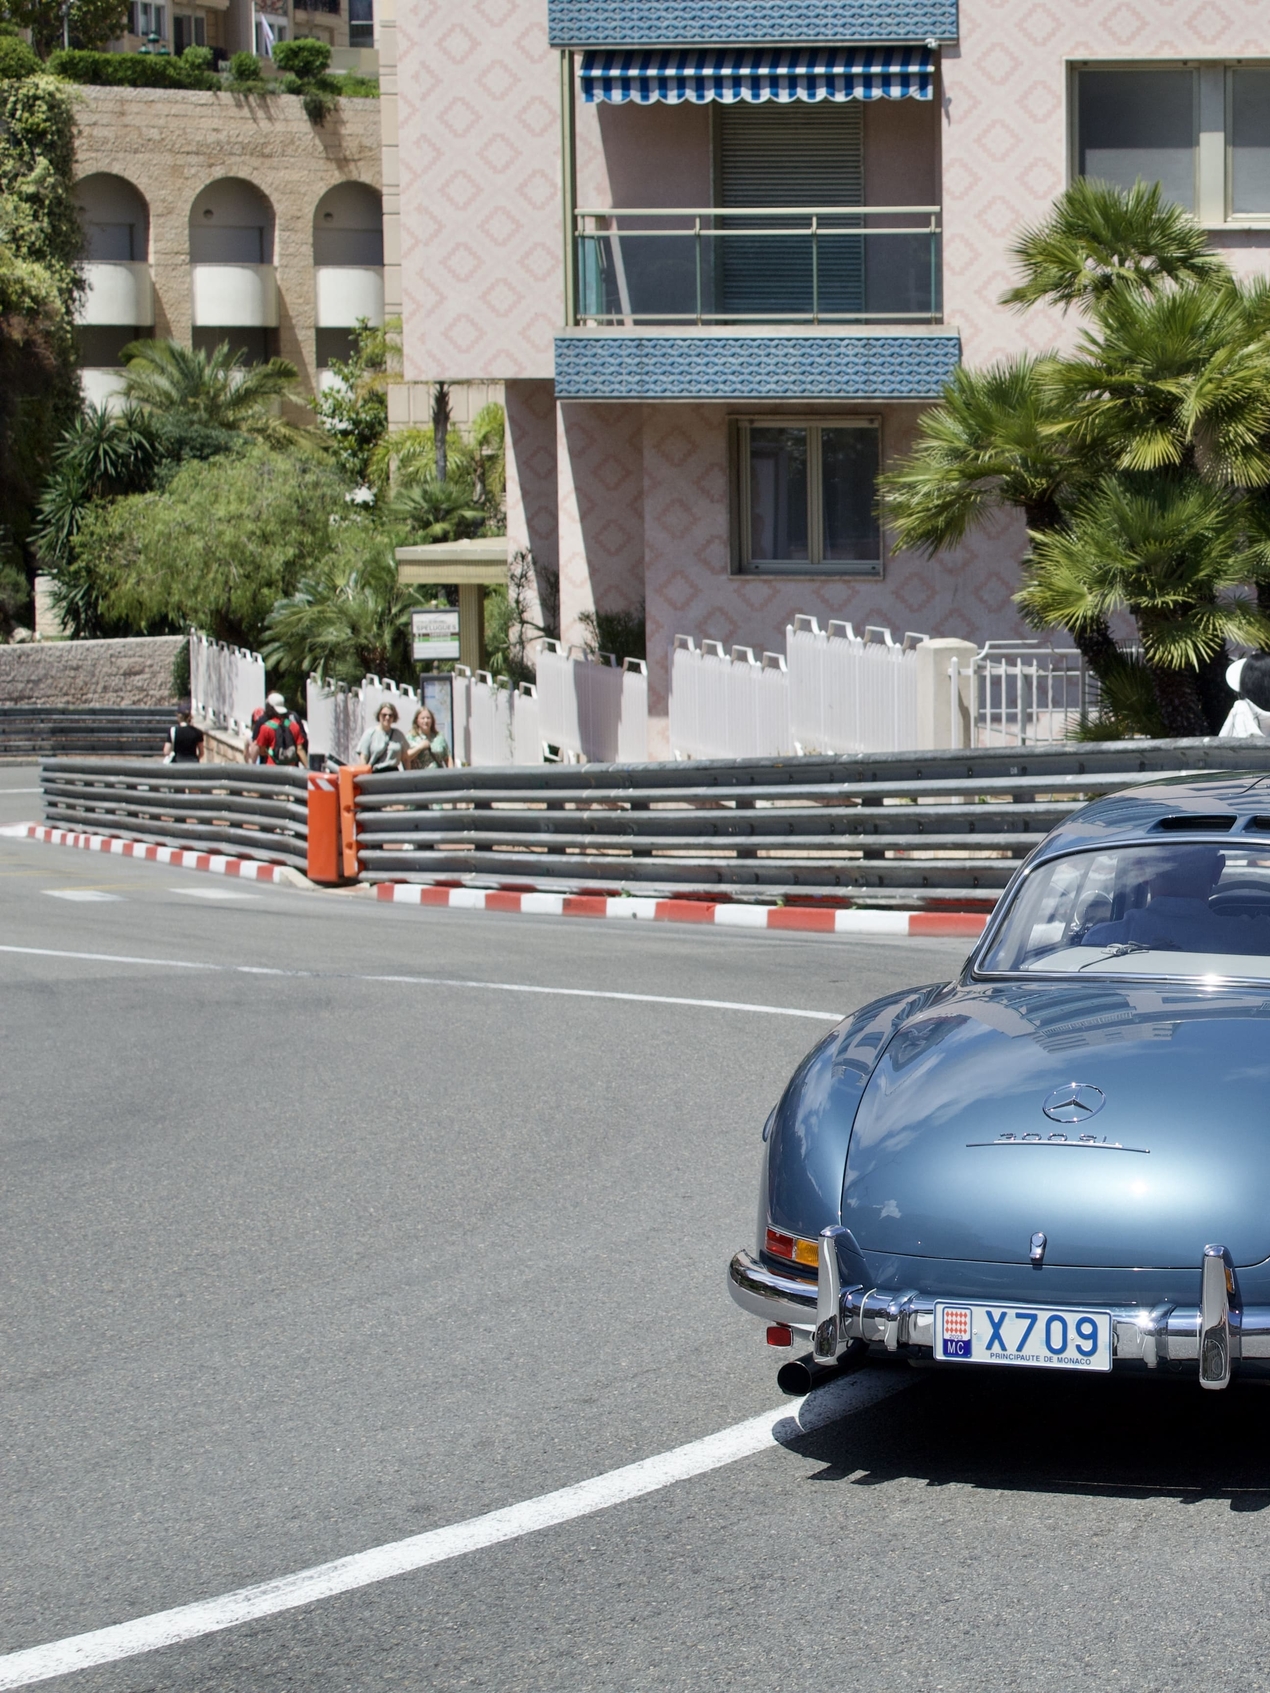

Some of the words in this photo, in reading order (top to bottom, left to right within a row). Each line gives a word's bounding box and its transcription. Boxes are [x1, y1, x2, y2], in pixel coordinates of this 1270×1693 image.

[985, 1310, 1098, 1357] X709
[947, 1341, 964, 1354] MC
[990, 1352, 1041, 1363] PRINCIPAUTE
[1057, 1356, 1091, 1365] MONACO
